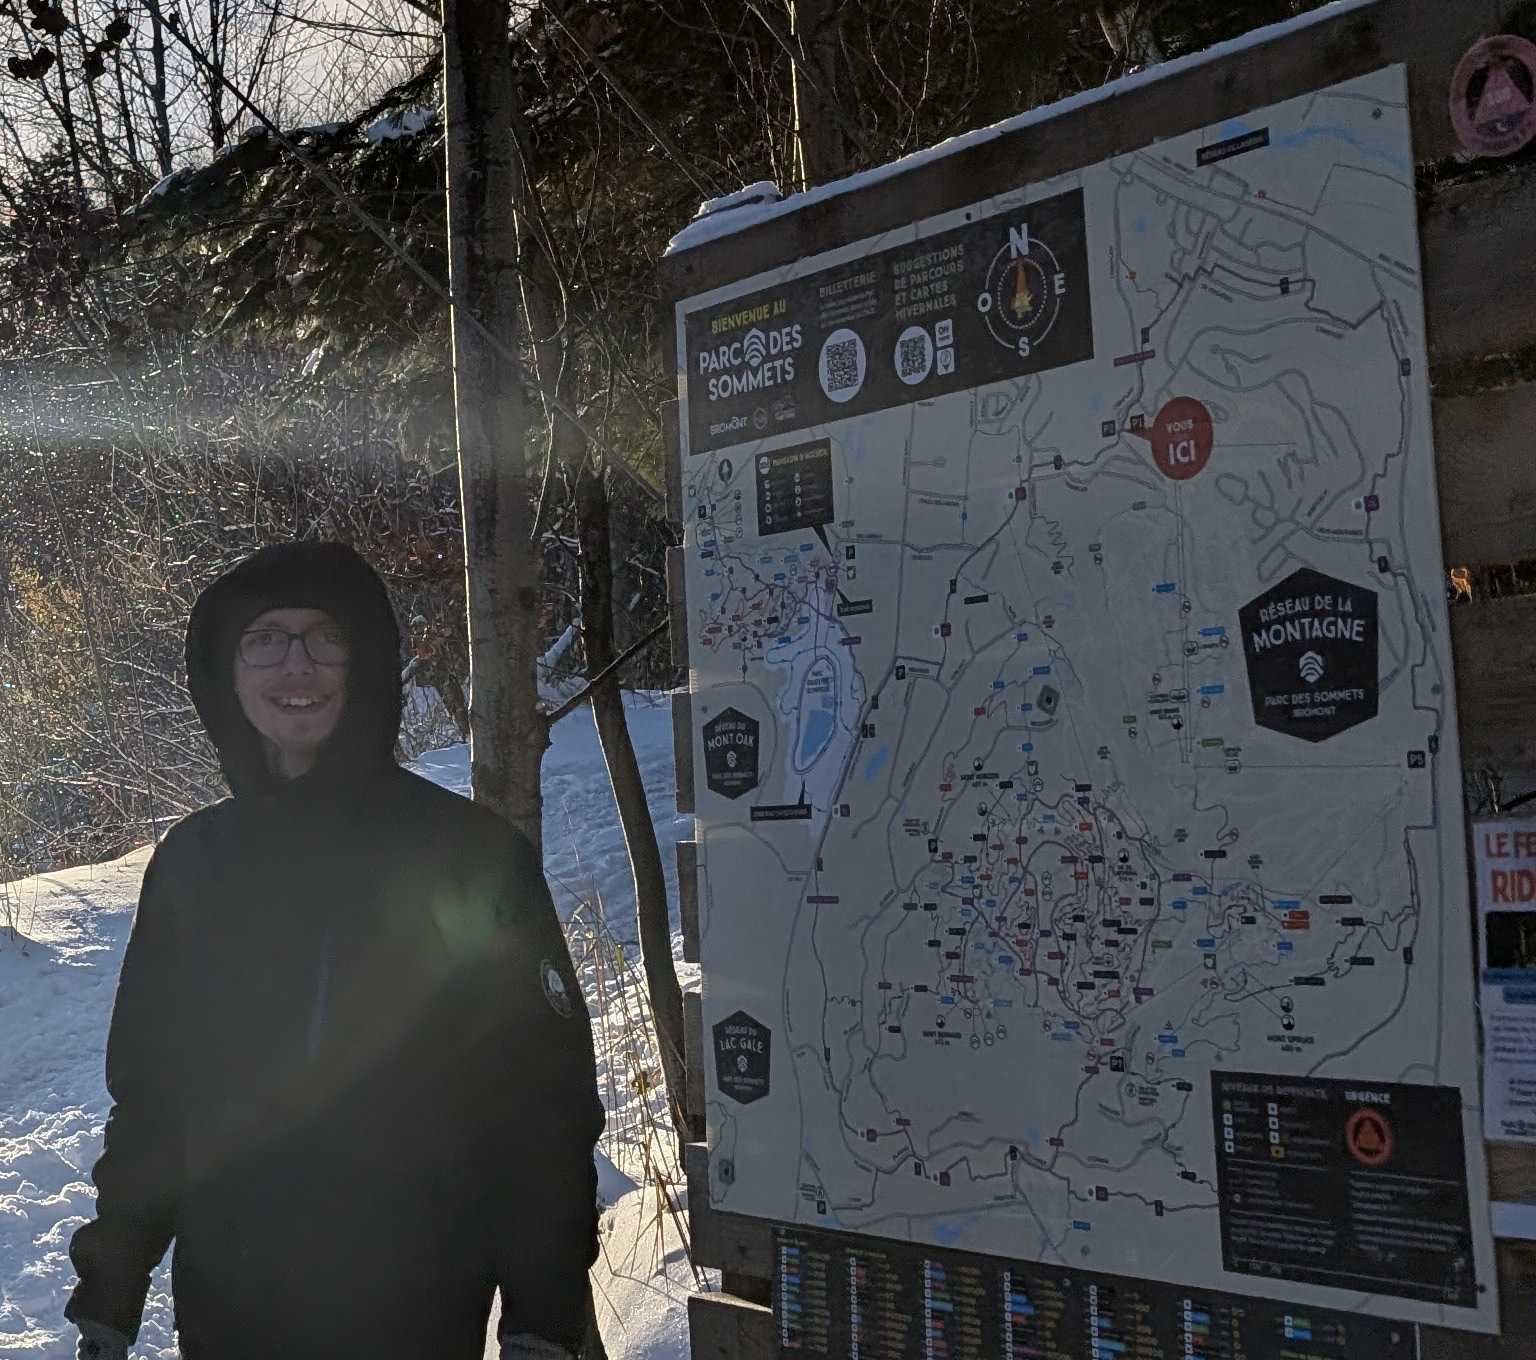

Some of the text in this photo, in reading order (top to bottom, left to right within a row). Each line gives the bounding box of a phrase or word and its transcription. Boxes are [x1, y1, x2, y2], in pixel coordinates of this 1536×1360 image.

[1009, 223, 1029, 259] N
[894, 243, 965, 275] SUGGESTIONS
[819, 271, 879, 298] BILLETTERIE
[910, 260, 964, 287] PARCOURS
[1054, 272, 1066, 295] E
[910, 280, 949, 301] CARTES
[977, 292, 992, 313] O
[711, 297, 787, 335] BIENVENUE AU
[895, 293, 957, 321] HIVERNALES
[699, 323, 802, 375] PARC DES
[1018, 336, 1030, 357] S
[708, 356, 795, 401] SOMMETS
[1168, 440, 1196, 465] ICI
[1314, 593, 1333, 611] DE
[1338, 596, 1353, 612] LA
[1252, 617, 1366, 653] MONTAGNE
[1264, 688, 1365, 706] PARC DES SOMMETS
[707, 733, 734, 751] MONT
[1486, 831, 1510, 858] LE
